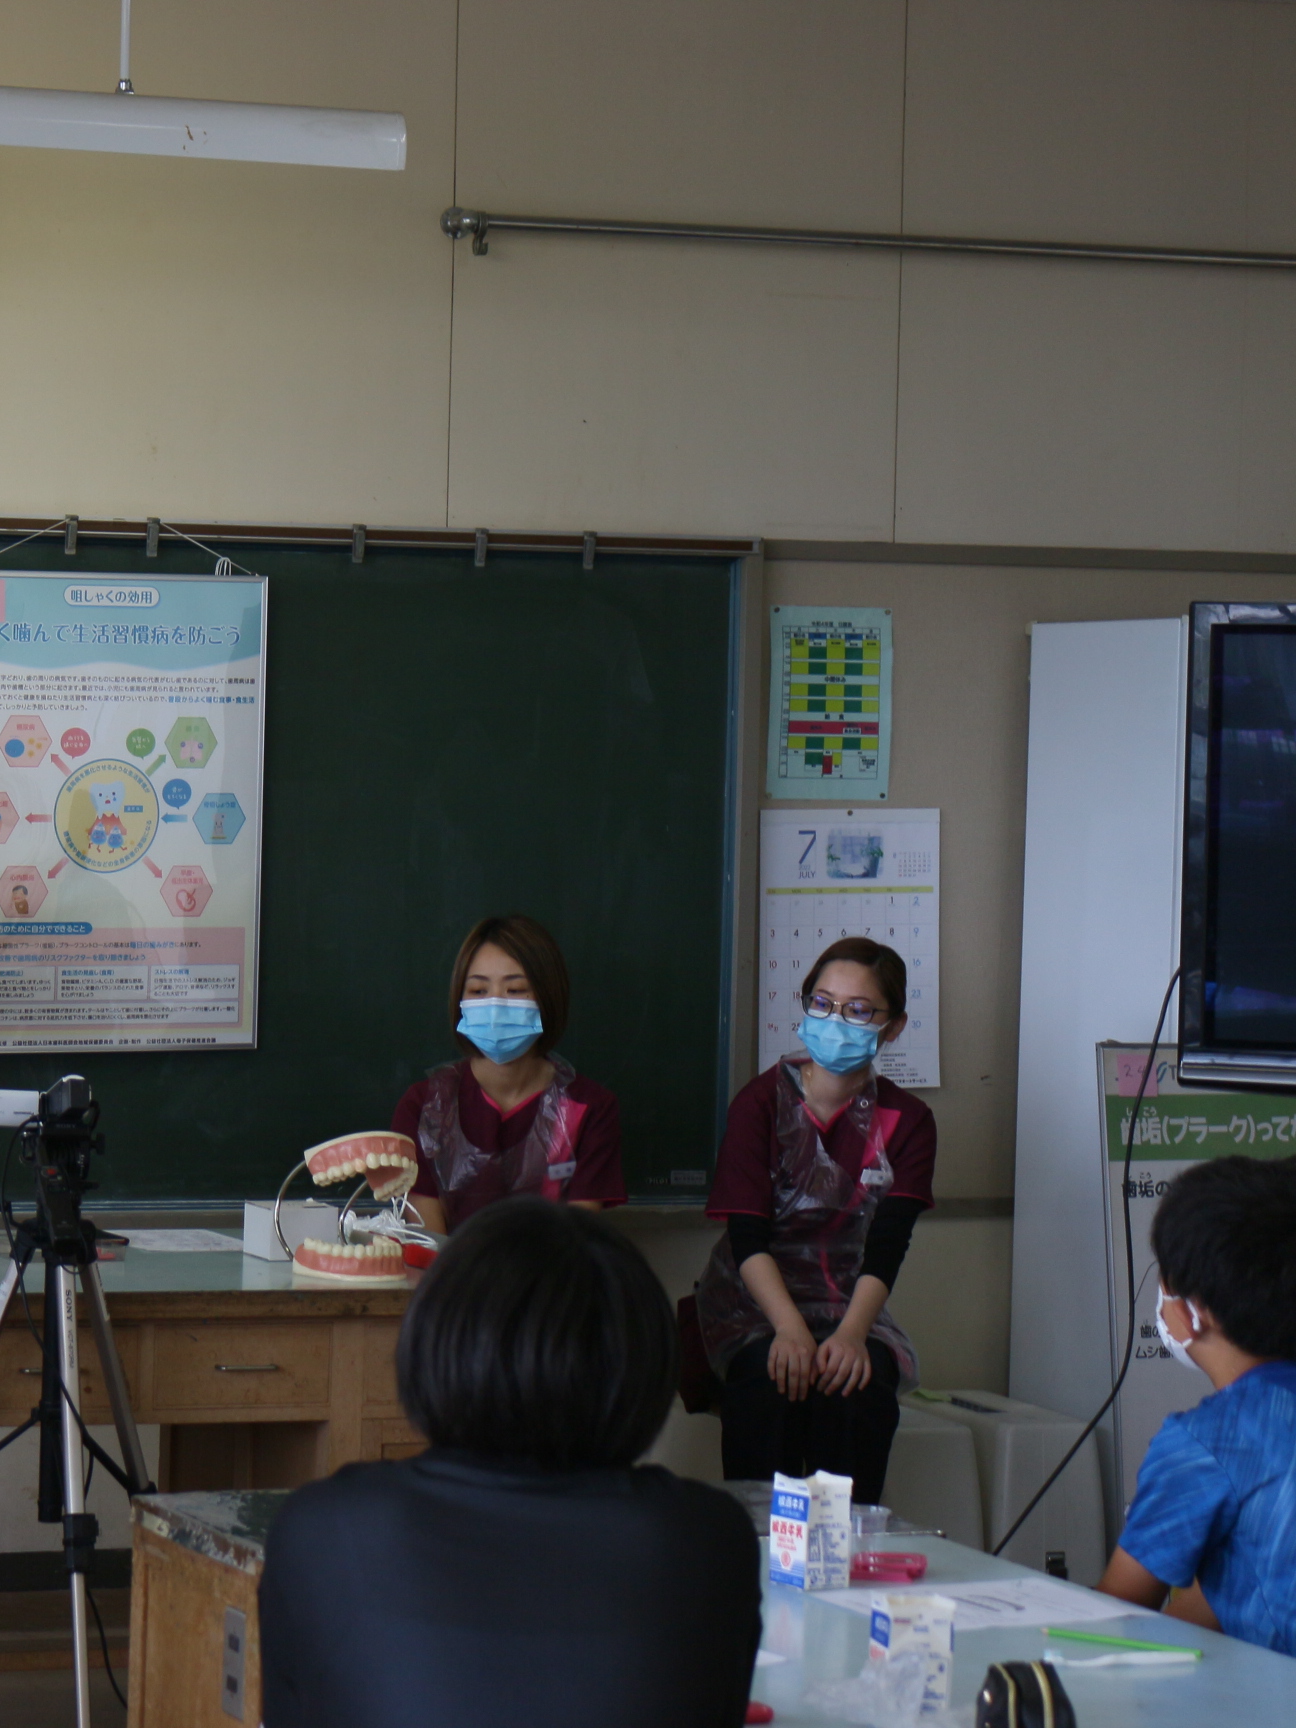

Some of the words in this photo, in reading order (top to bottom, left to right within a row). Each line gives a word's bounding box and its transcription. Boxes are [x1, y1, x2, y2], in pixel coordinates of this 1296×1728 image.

[798, 830, 816, 864] 7
[798, 870, 816, 879] JULY
[794, 928, 799, 936] 4
[818, 928, 823, 936] 5
[865, 928, 870, 936] 7
[890, 928, 894, 936] 8
[769, 960, 777, 968] 10
[768, 992, 776, 1000] 17
